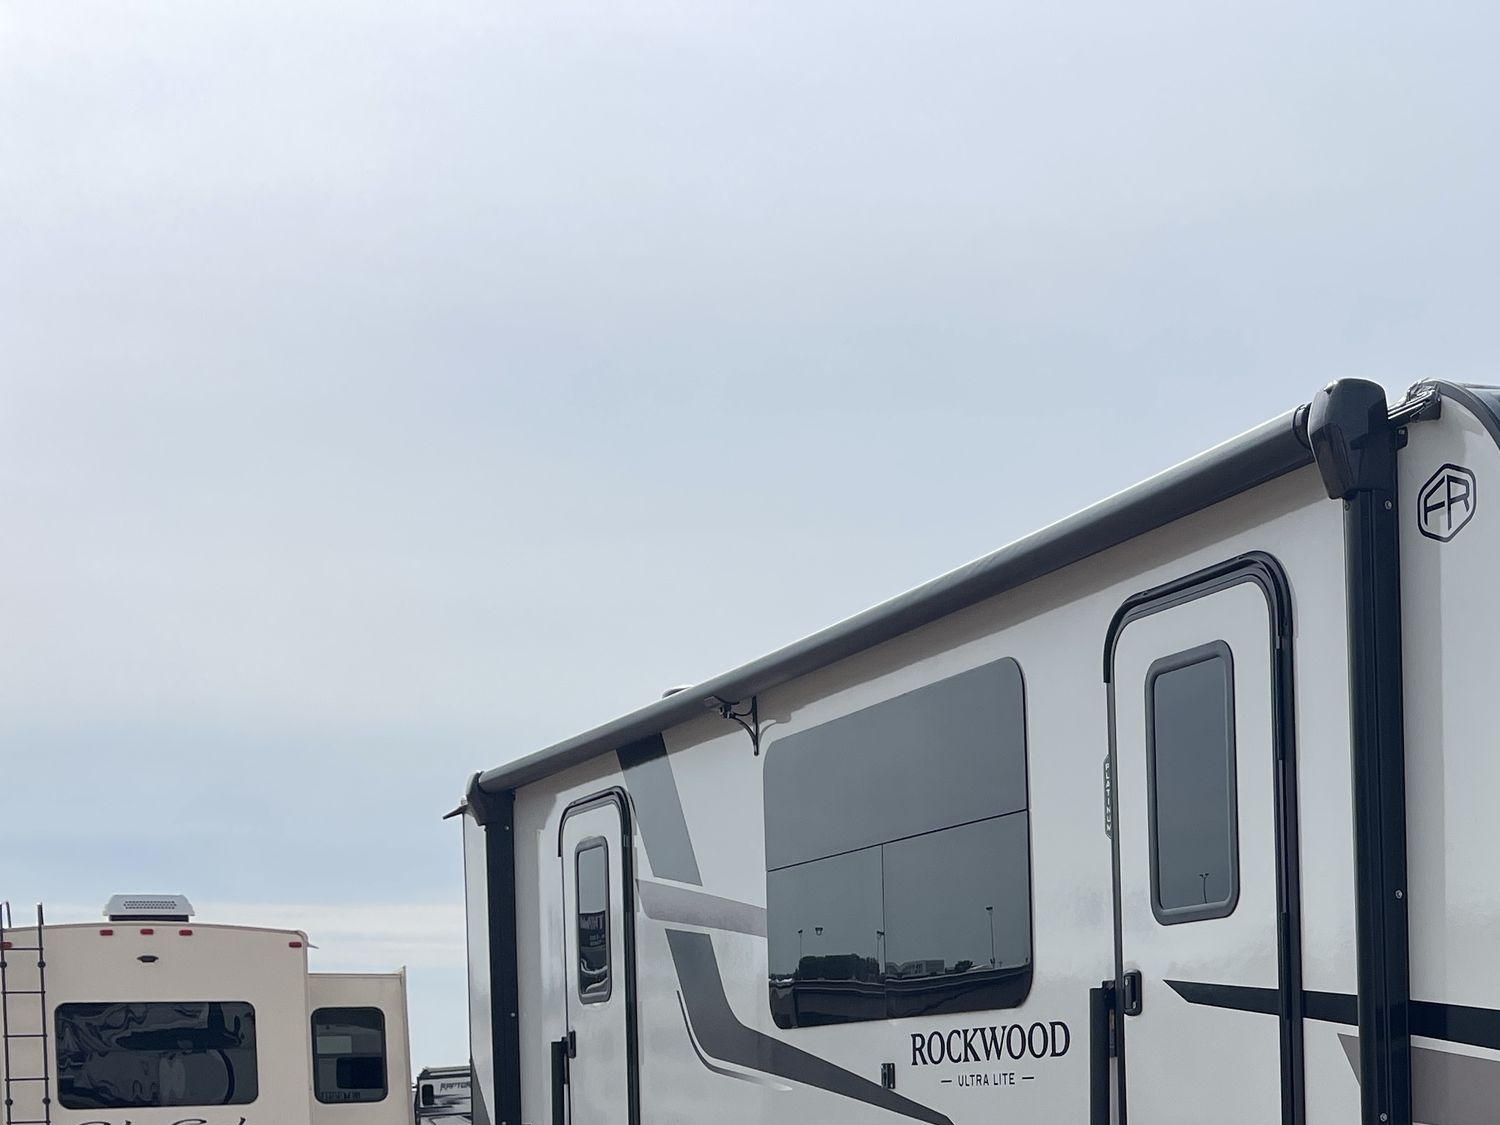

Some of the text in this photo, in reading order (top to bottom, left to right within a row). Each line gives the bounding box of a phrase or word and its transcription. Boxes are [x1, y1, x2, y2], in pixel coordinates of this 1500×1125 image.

[911, 1021, 1071, 1066] ROCKWOOD
[958, 1072, 1016, 1087] ULTRA LITE
